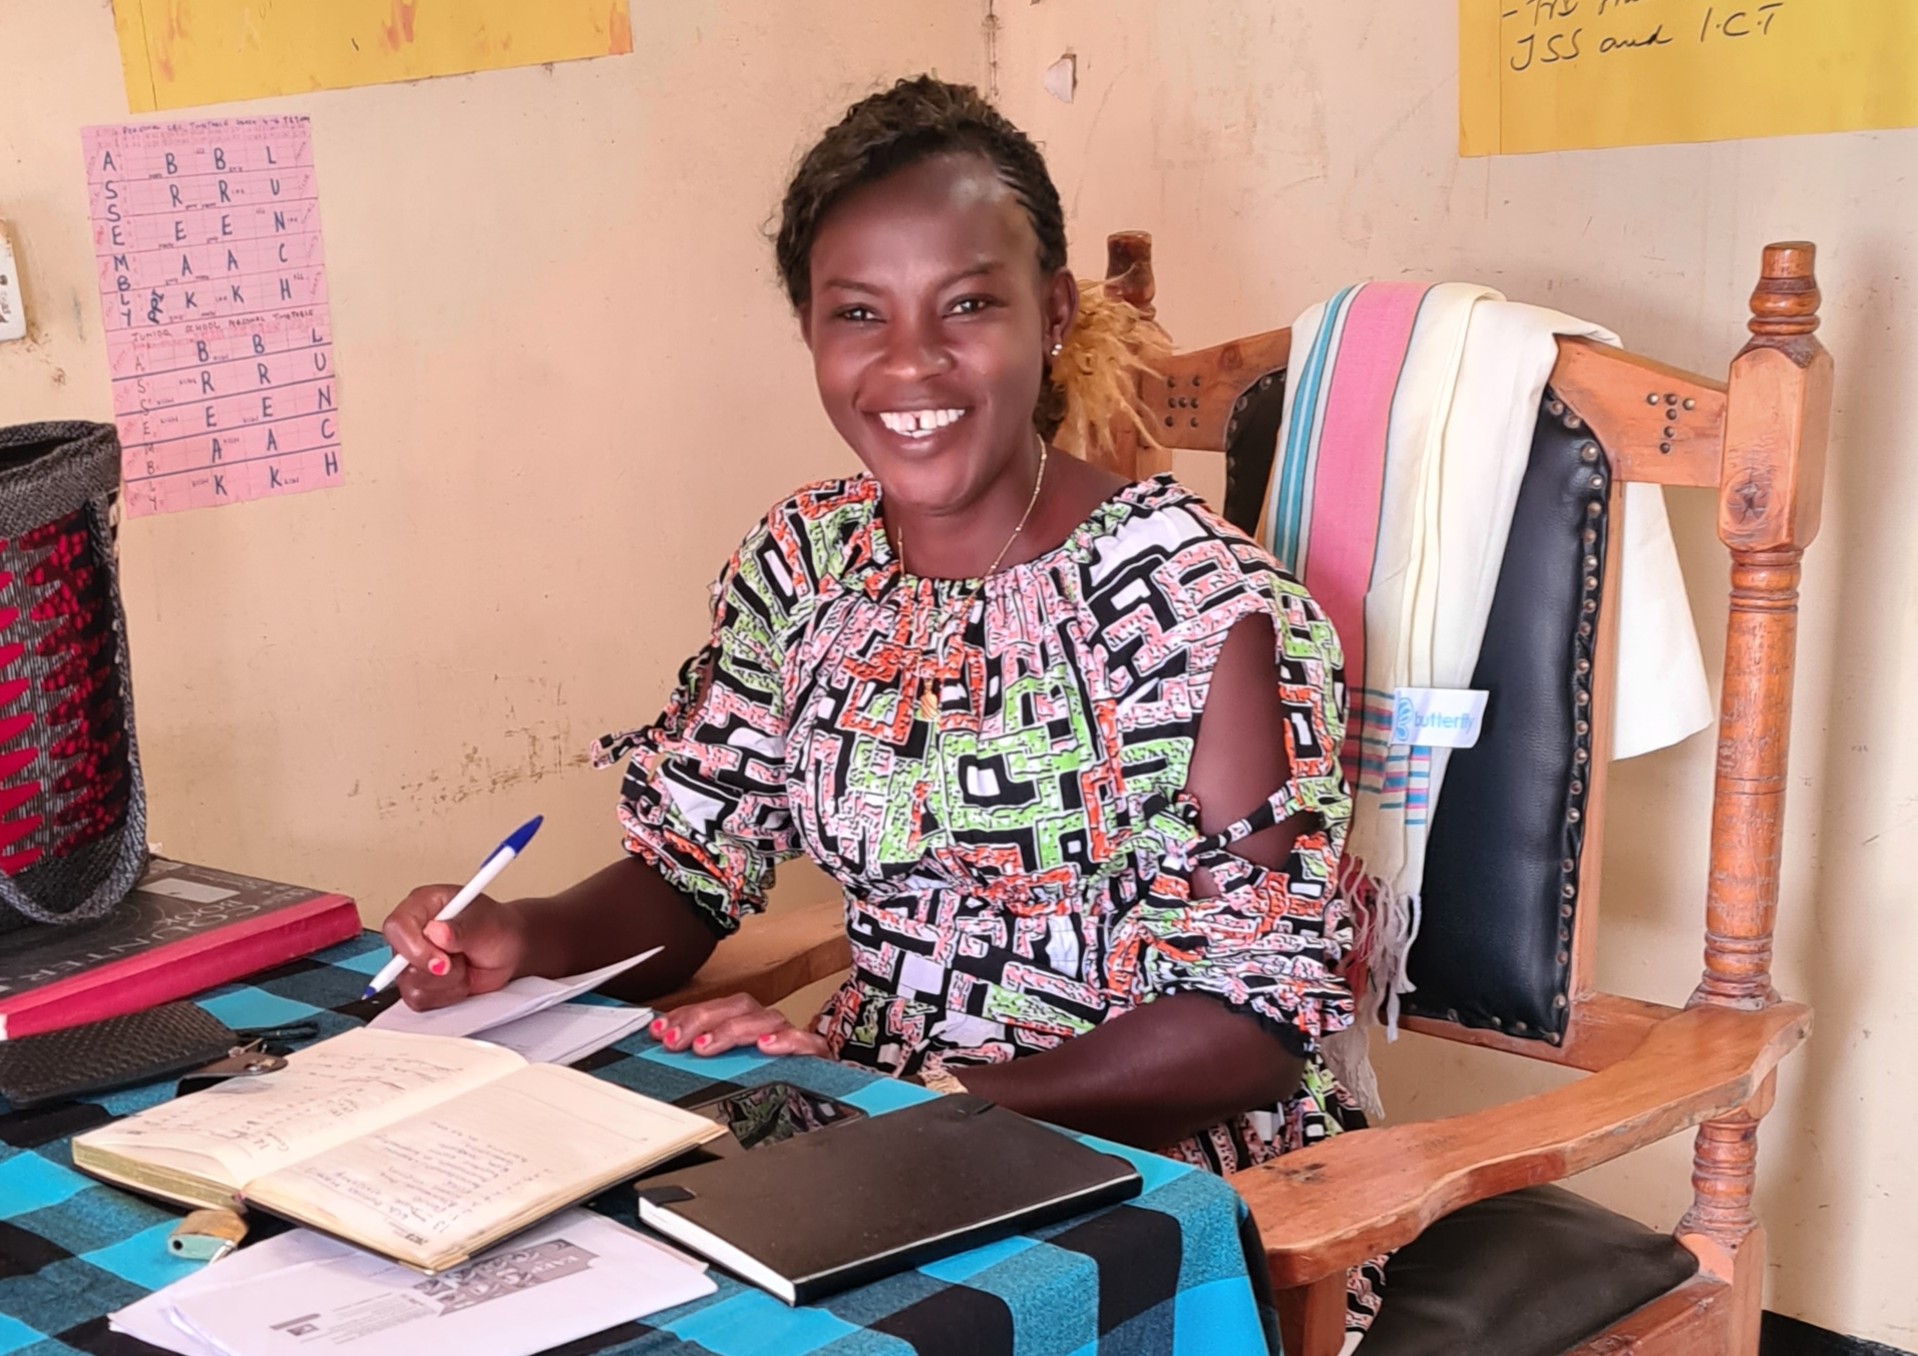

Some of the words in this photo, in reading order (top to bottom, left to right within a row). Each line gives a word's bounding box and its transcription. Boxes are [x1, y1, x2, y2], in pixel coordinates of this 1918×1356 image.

[1510, 28, 1583, 71] JSS
[1598, 25, 1674, 55] and
[1414, 711, 1475, 734] butterfly
[154, 900, 243, 926] BOOK
[20, 905, 260, 982] COUNTER
